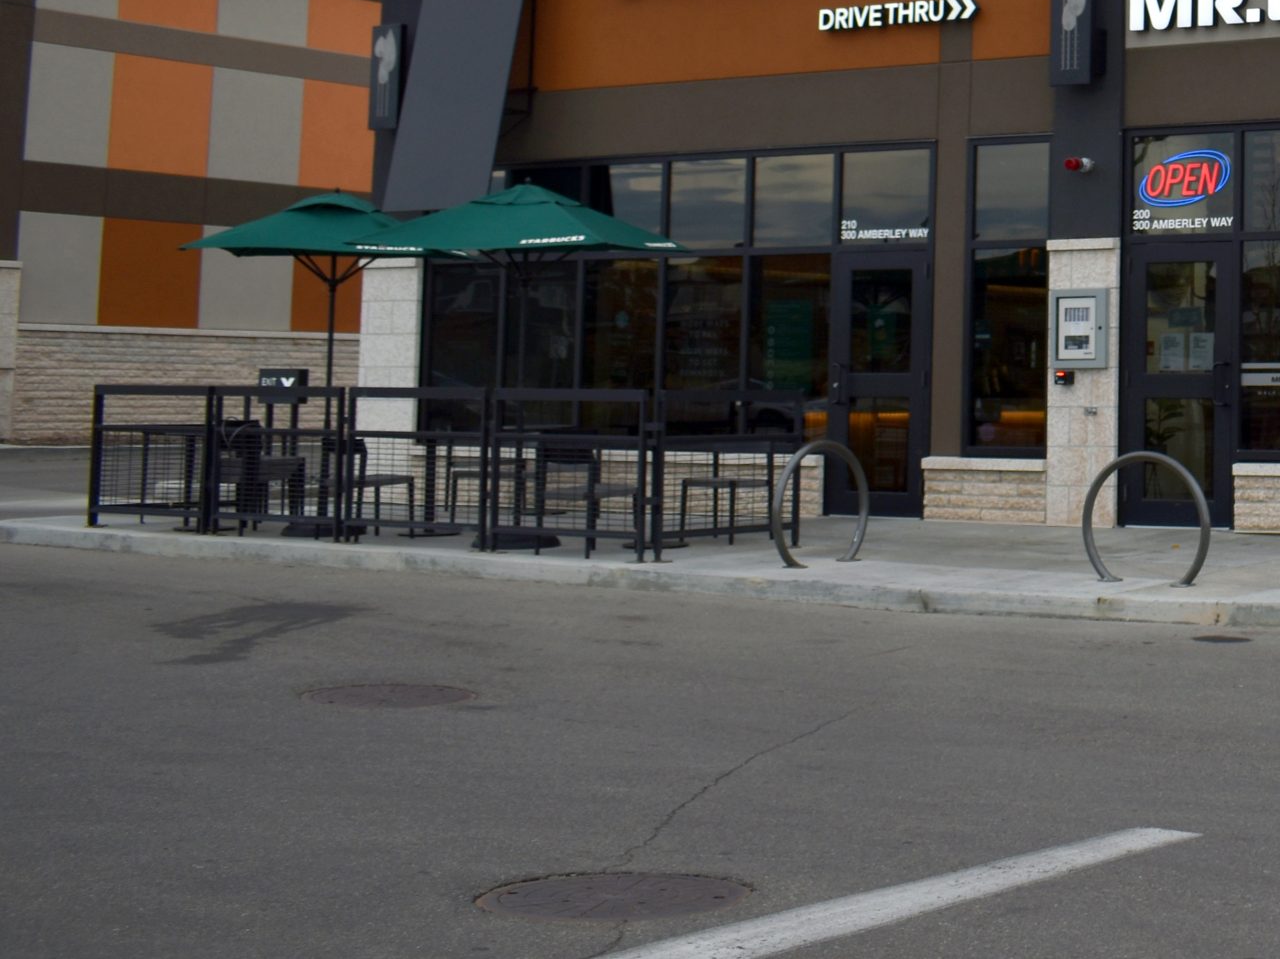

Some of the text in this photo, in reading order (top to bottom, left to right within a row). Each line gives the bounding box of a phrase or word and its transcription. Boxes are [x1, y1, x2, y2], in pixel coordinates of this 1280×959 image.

[818, 3, 883, 31] DRIVE
[1146, 161, 1220, 197] OPEN
[1132, 209, 1151, 220] 200
[841, 220, 858, 230] 210
[1132, 216, 1234, 231] 300 AMBERLEY WAY
[519, 234, 586, 245] STARBUCKS
[840, 228, 930, 240] 300 AMBERLEY WAY
